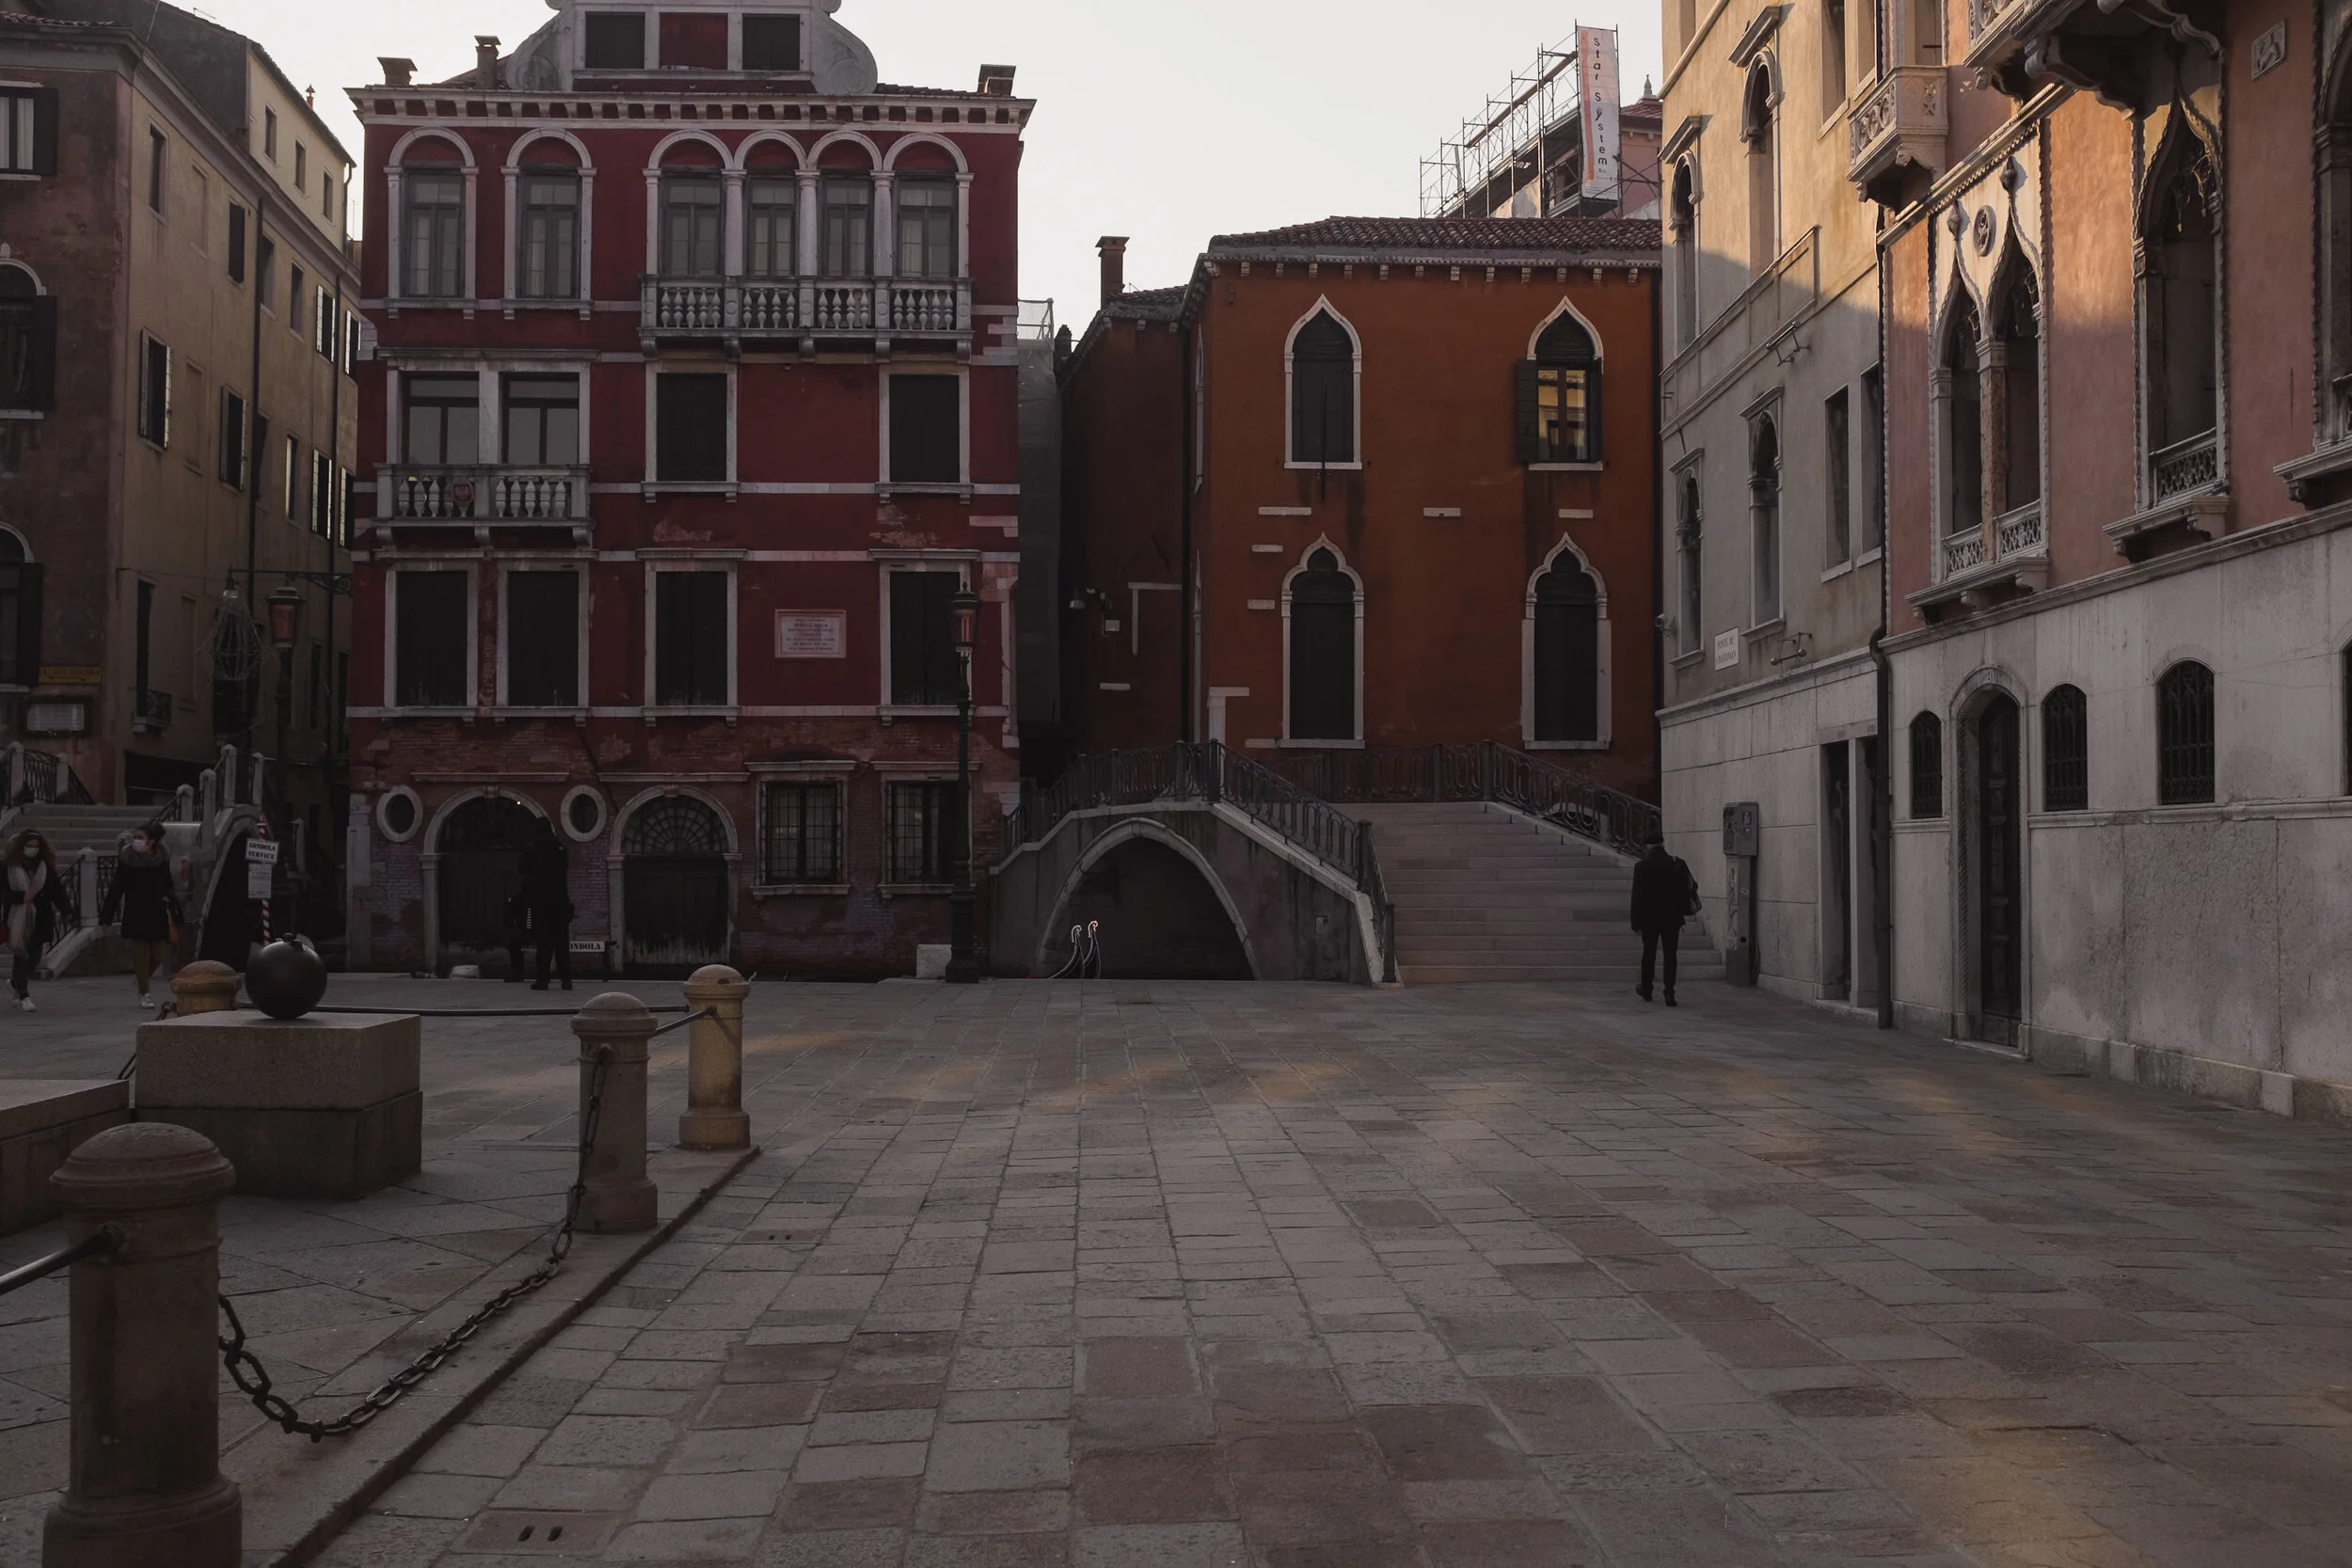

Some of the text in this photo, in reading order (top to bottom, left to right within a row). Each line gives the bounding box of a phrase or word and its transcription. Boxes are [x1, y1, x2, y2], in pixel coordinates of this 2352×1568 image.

[1593, 37, 1601, 81] Star
[1595, 91, 1608, 166] System
[248, 842, 276, 851] GONDOLA
[248, 850, 275, 860] SERVICE
